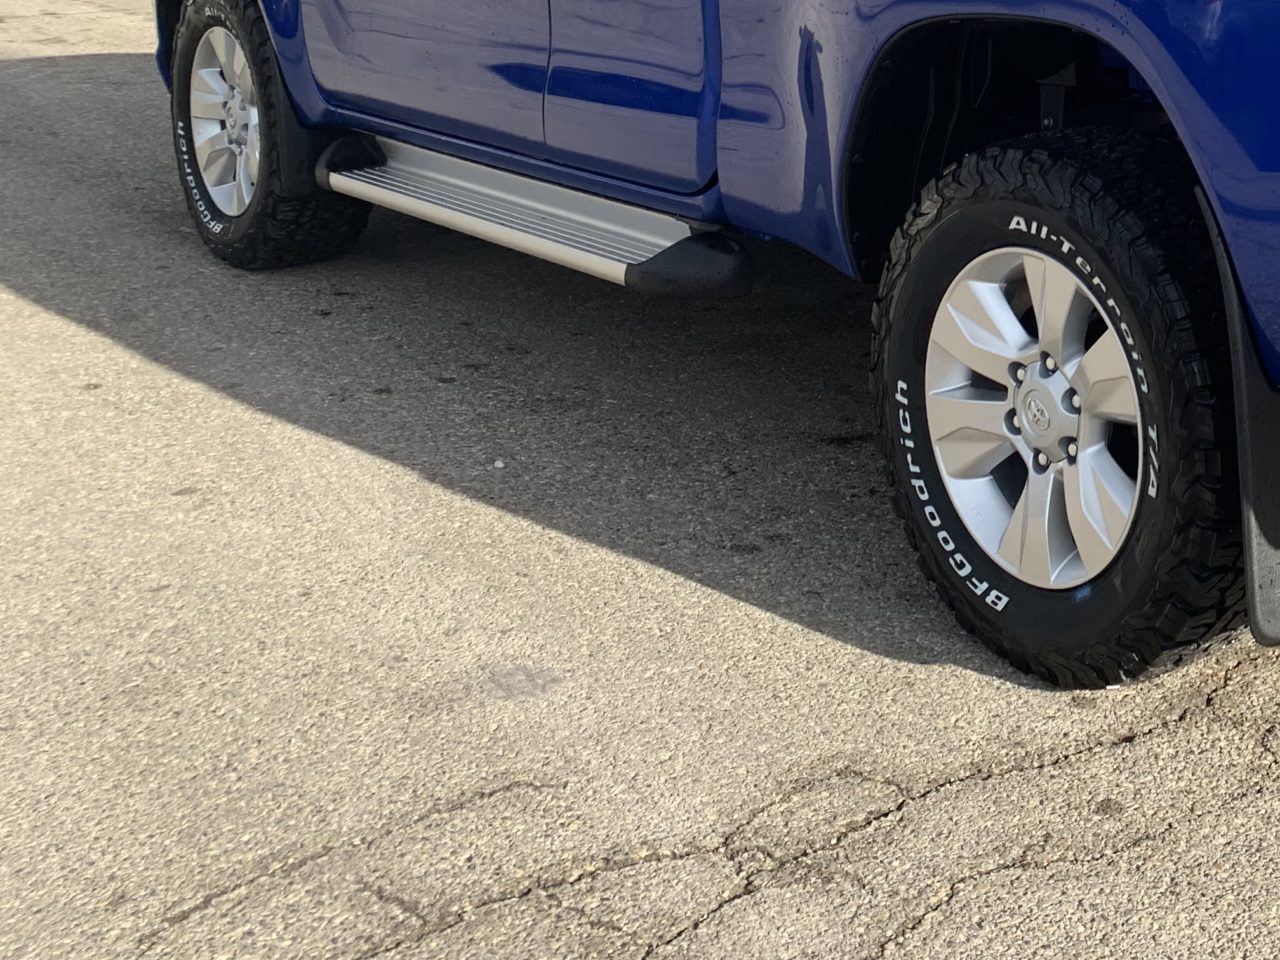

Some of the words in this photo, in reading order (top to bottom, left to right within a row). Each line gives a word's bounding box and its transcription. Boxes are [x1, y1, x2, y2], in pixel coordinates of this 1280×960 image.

[178, 121, 223, 233] BFGoodrich
[1008, 215, 1149, 394] All-Terrain
[1147, 423, 1160, 499] T/A
[894, 379, 1010, 612] BFGoodrich
